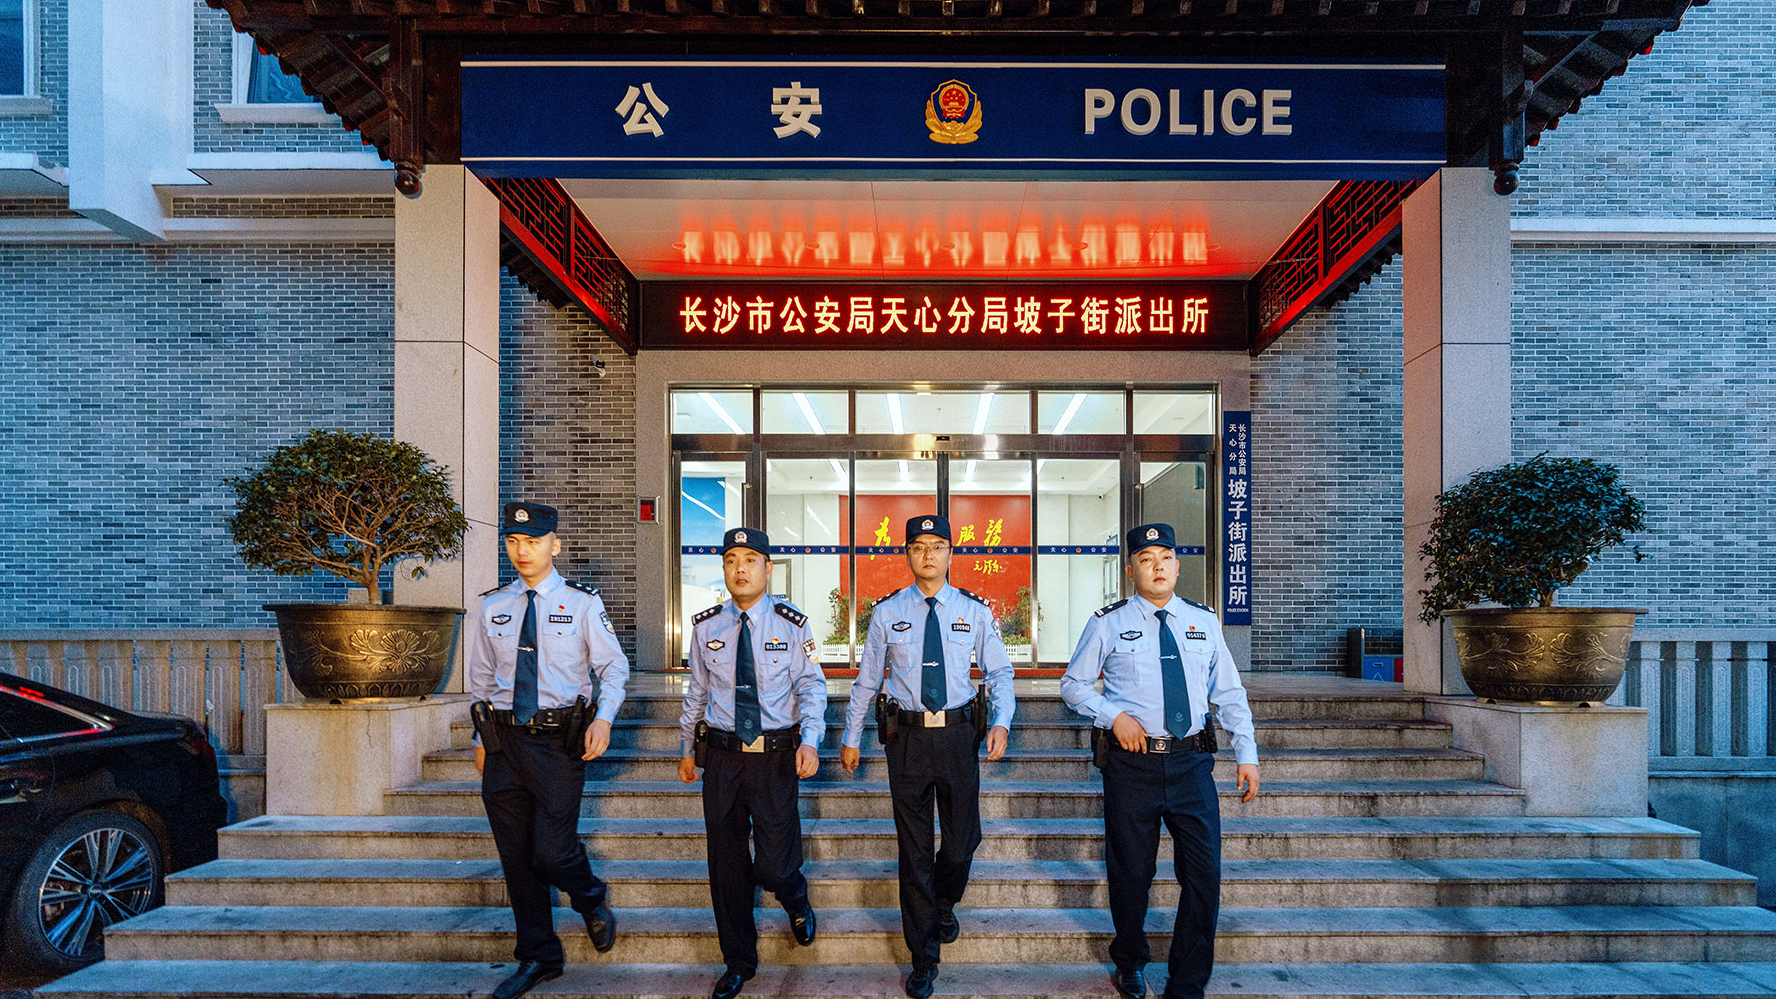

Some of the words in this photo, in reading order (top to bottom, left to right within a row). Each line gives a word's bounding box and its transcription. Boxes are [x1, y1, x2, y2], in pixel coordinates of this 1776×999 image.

[1085, 88, 1292, 135] POLICE
[680, 296, 1209, 334] 长沙市公安局天心分局坡子街派出所
[1229, 424, 1237, 475] 天心分局
[1238, 424, 1246, 475] 长沙市公安局
[1228, 479, 1247, 605] 坡子街派出所
